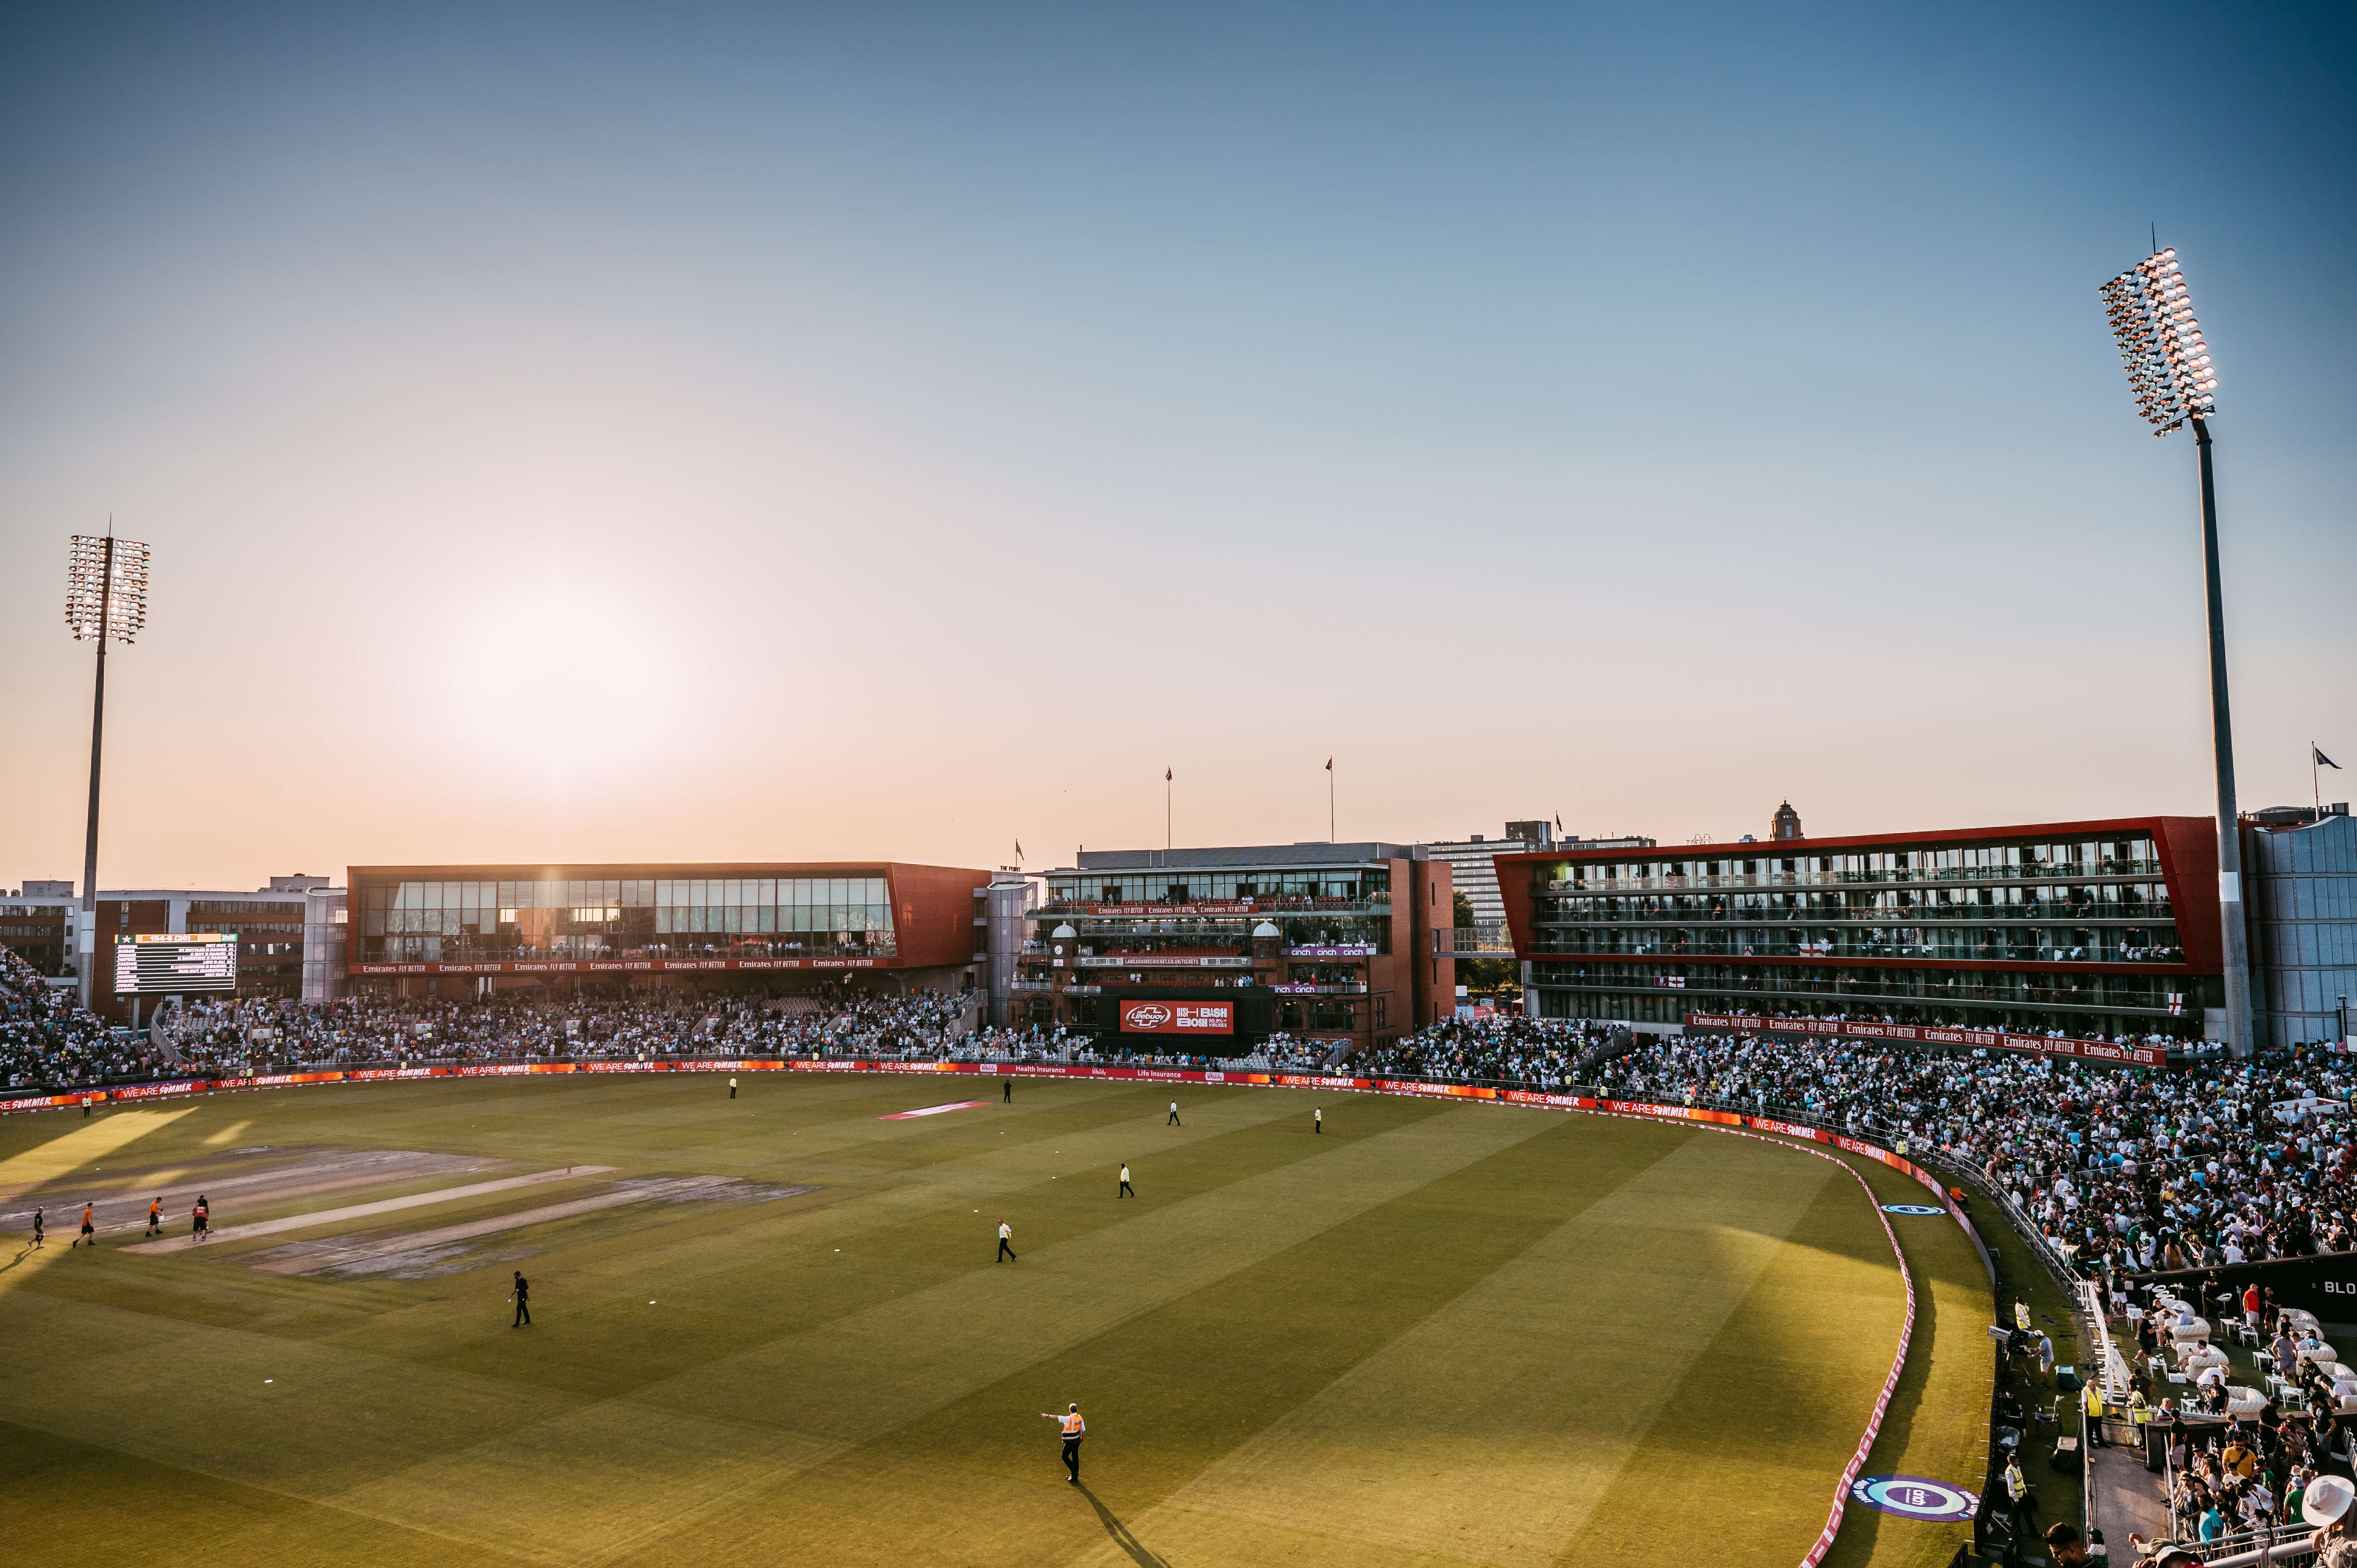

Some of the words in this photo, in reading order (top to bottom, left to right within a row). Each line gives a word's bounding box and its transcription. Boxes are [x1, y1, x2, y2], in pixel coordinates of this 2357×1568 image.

[1177, 1008, 1198, 1017] BISH
[1200, 1008, 1227, 1018] BASH
[1177, 1018, 1207, 1027] BOSH
[1693, 1017, 1728, 1026] Emirates
[1732, 1018, 1740, 1027] FLY
[1742, 1019, 1760, 1028] BETTER
[1770, 1020, 1805, 1030] Emirates
[1808, 1022, 1817, 1031] FLY
[1819, 1022, 1838, 1032] BETTER
[1846, 1024, 1883, 1035] Emirates
[1887, 1027, 1896, 1037] FLY
[1897, 1028, 1916, 1038] BETTER
[1925, 1029, 1962, 1042] Emirates
[1965, 1033, 1974, 1043] FLY
[1975, 1034, 1995, 1045] BETTER
[2004, 1036, 2041, 1049] Emirates
[2044, 1039, 2053, 1051] FLY
[2055, 1041, 2074, 1053] BETTER
[2084, 1043, 2120, 1058] Emirates
[2133, 1049, 2153, 1062] BETTER
[396, 1068, 431, 1077] SUMMER
[1092, 1067, 1106, 1076] Vitality
[256, 1075, 292, 1085] SUMMER
[1301, 1077, 1320, 1085] ARE
[1321, 1078, 1353, 1086] SUMMER
[123, 1089, 138, 1097] WE
[140, 1087, 158, 1096] ARE
[159, 1084, 192, 1094] SUMMER
[1385, 1081, 1398, 1089] WE
[1401, 1082, 1417, 1091] ARE
[1418, 1084, 1449, 1093] SUMMER
[12, 1097, 51, 1109] SUMMER
[1511, 1092, 1525, 1101] WE
[1527, 1093, 1545, 1103] ARE
[1546, 1095, 1579, 1106] SUMMER
[1613, 1101, 1629, 1111] WE
[1631, 1103, 1651, 1114] ARE
[1652, 1105, 1690, 1118] SUMMER
[1755, 1119, 1769, 1130] WE
[1770, 1122, 1786, 1133] ARE
[1787, 1125, 1816, 1139] SUMMER
[1839, 1137, 1850, 1150] WE
[1852, 1141, 1865, 1154] ARE
[1865, 1145, 1886, 1162] SUMMER
[1916, 1168, 1924, 1183] WE
[1924, 1172, 1933, 1188] ARE
[2325, 1281, 2356, 1294] BLO
[1853, 1480, 1869, 1489] AND
[1853, 1490, 1874, 1503] WIN!
[1912, 1490, 1929, 1505] cinch
